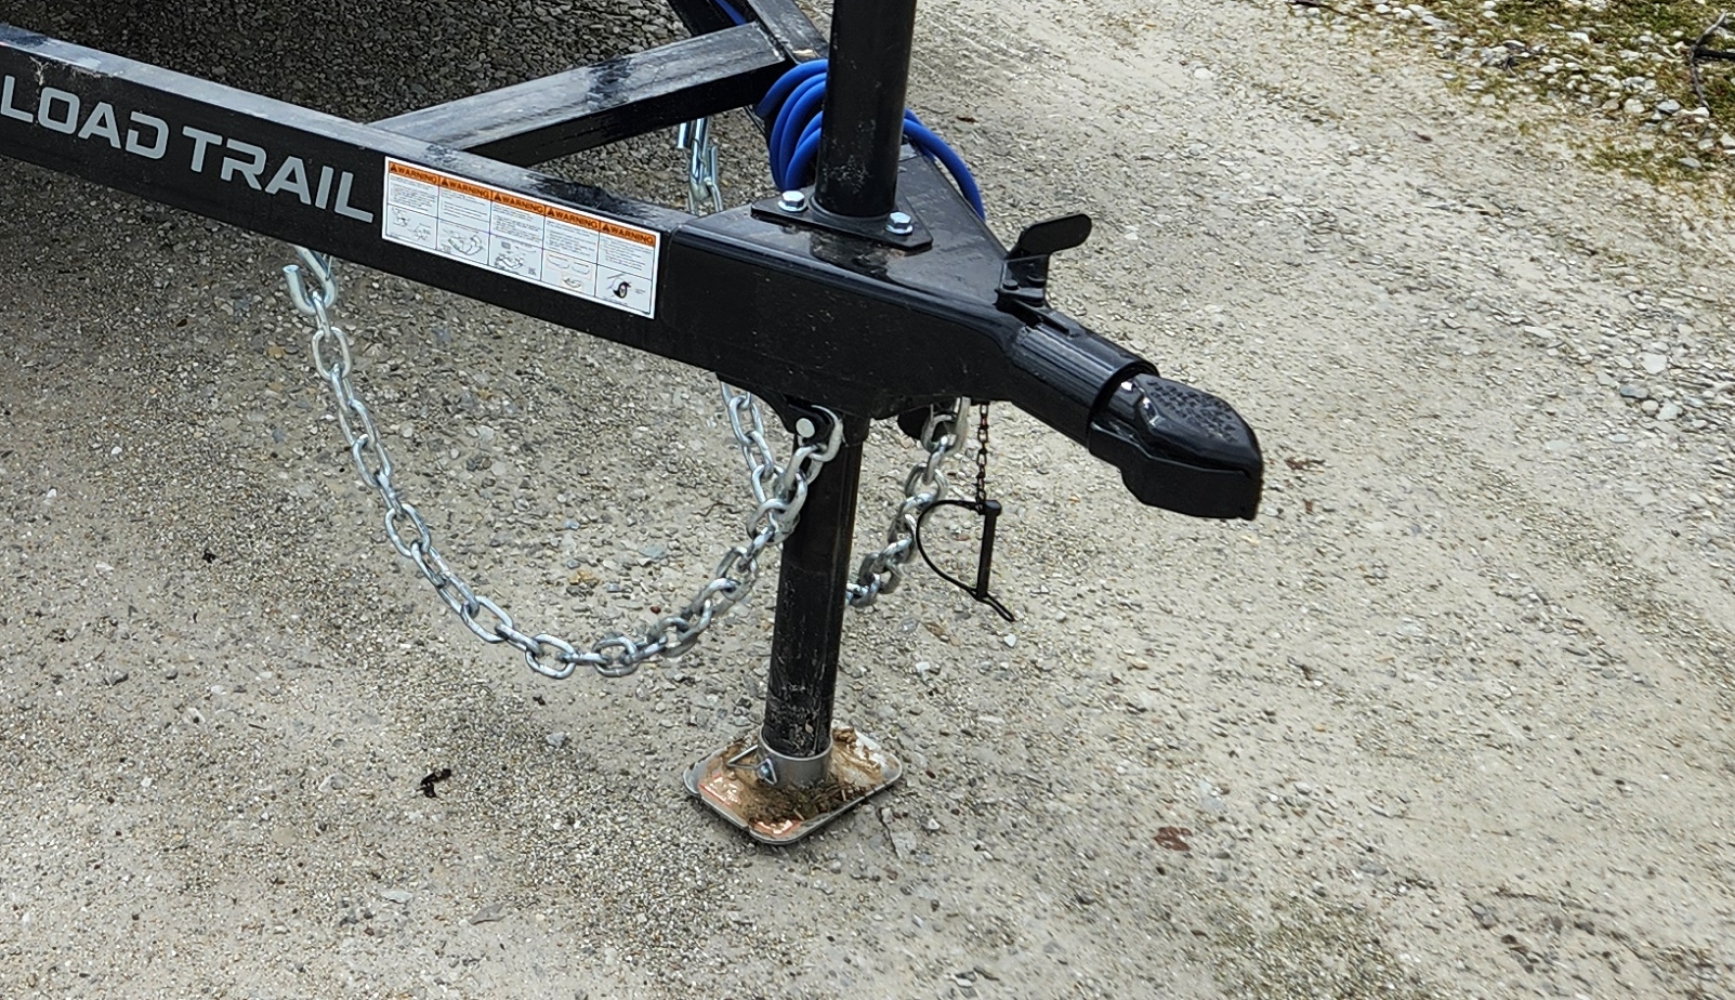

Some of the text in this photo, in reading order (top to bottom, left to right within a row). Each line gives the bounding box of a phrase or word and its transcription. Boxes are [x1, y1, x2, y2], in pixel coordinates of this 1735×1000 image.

[0, 75, 374, 224] LOAD TRAIL
[399, 166, 437, 184] WARNING
[450, 181, 489, 198] WARNING
[503, 196, 543, 214] WARNING
[556, 212, 598, 229] WARNING
[611, 226, 654, 244] WARNING
